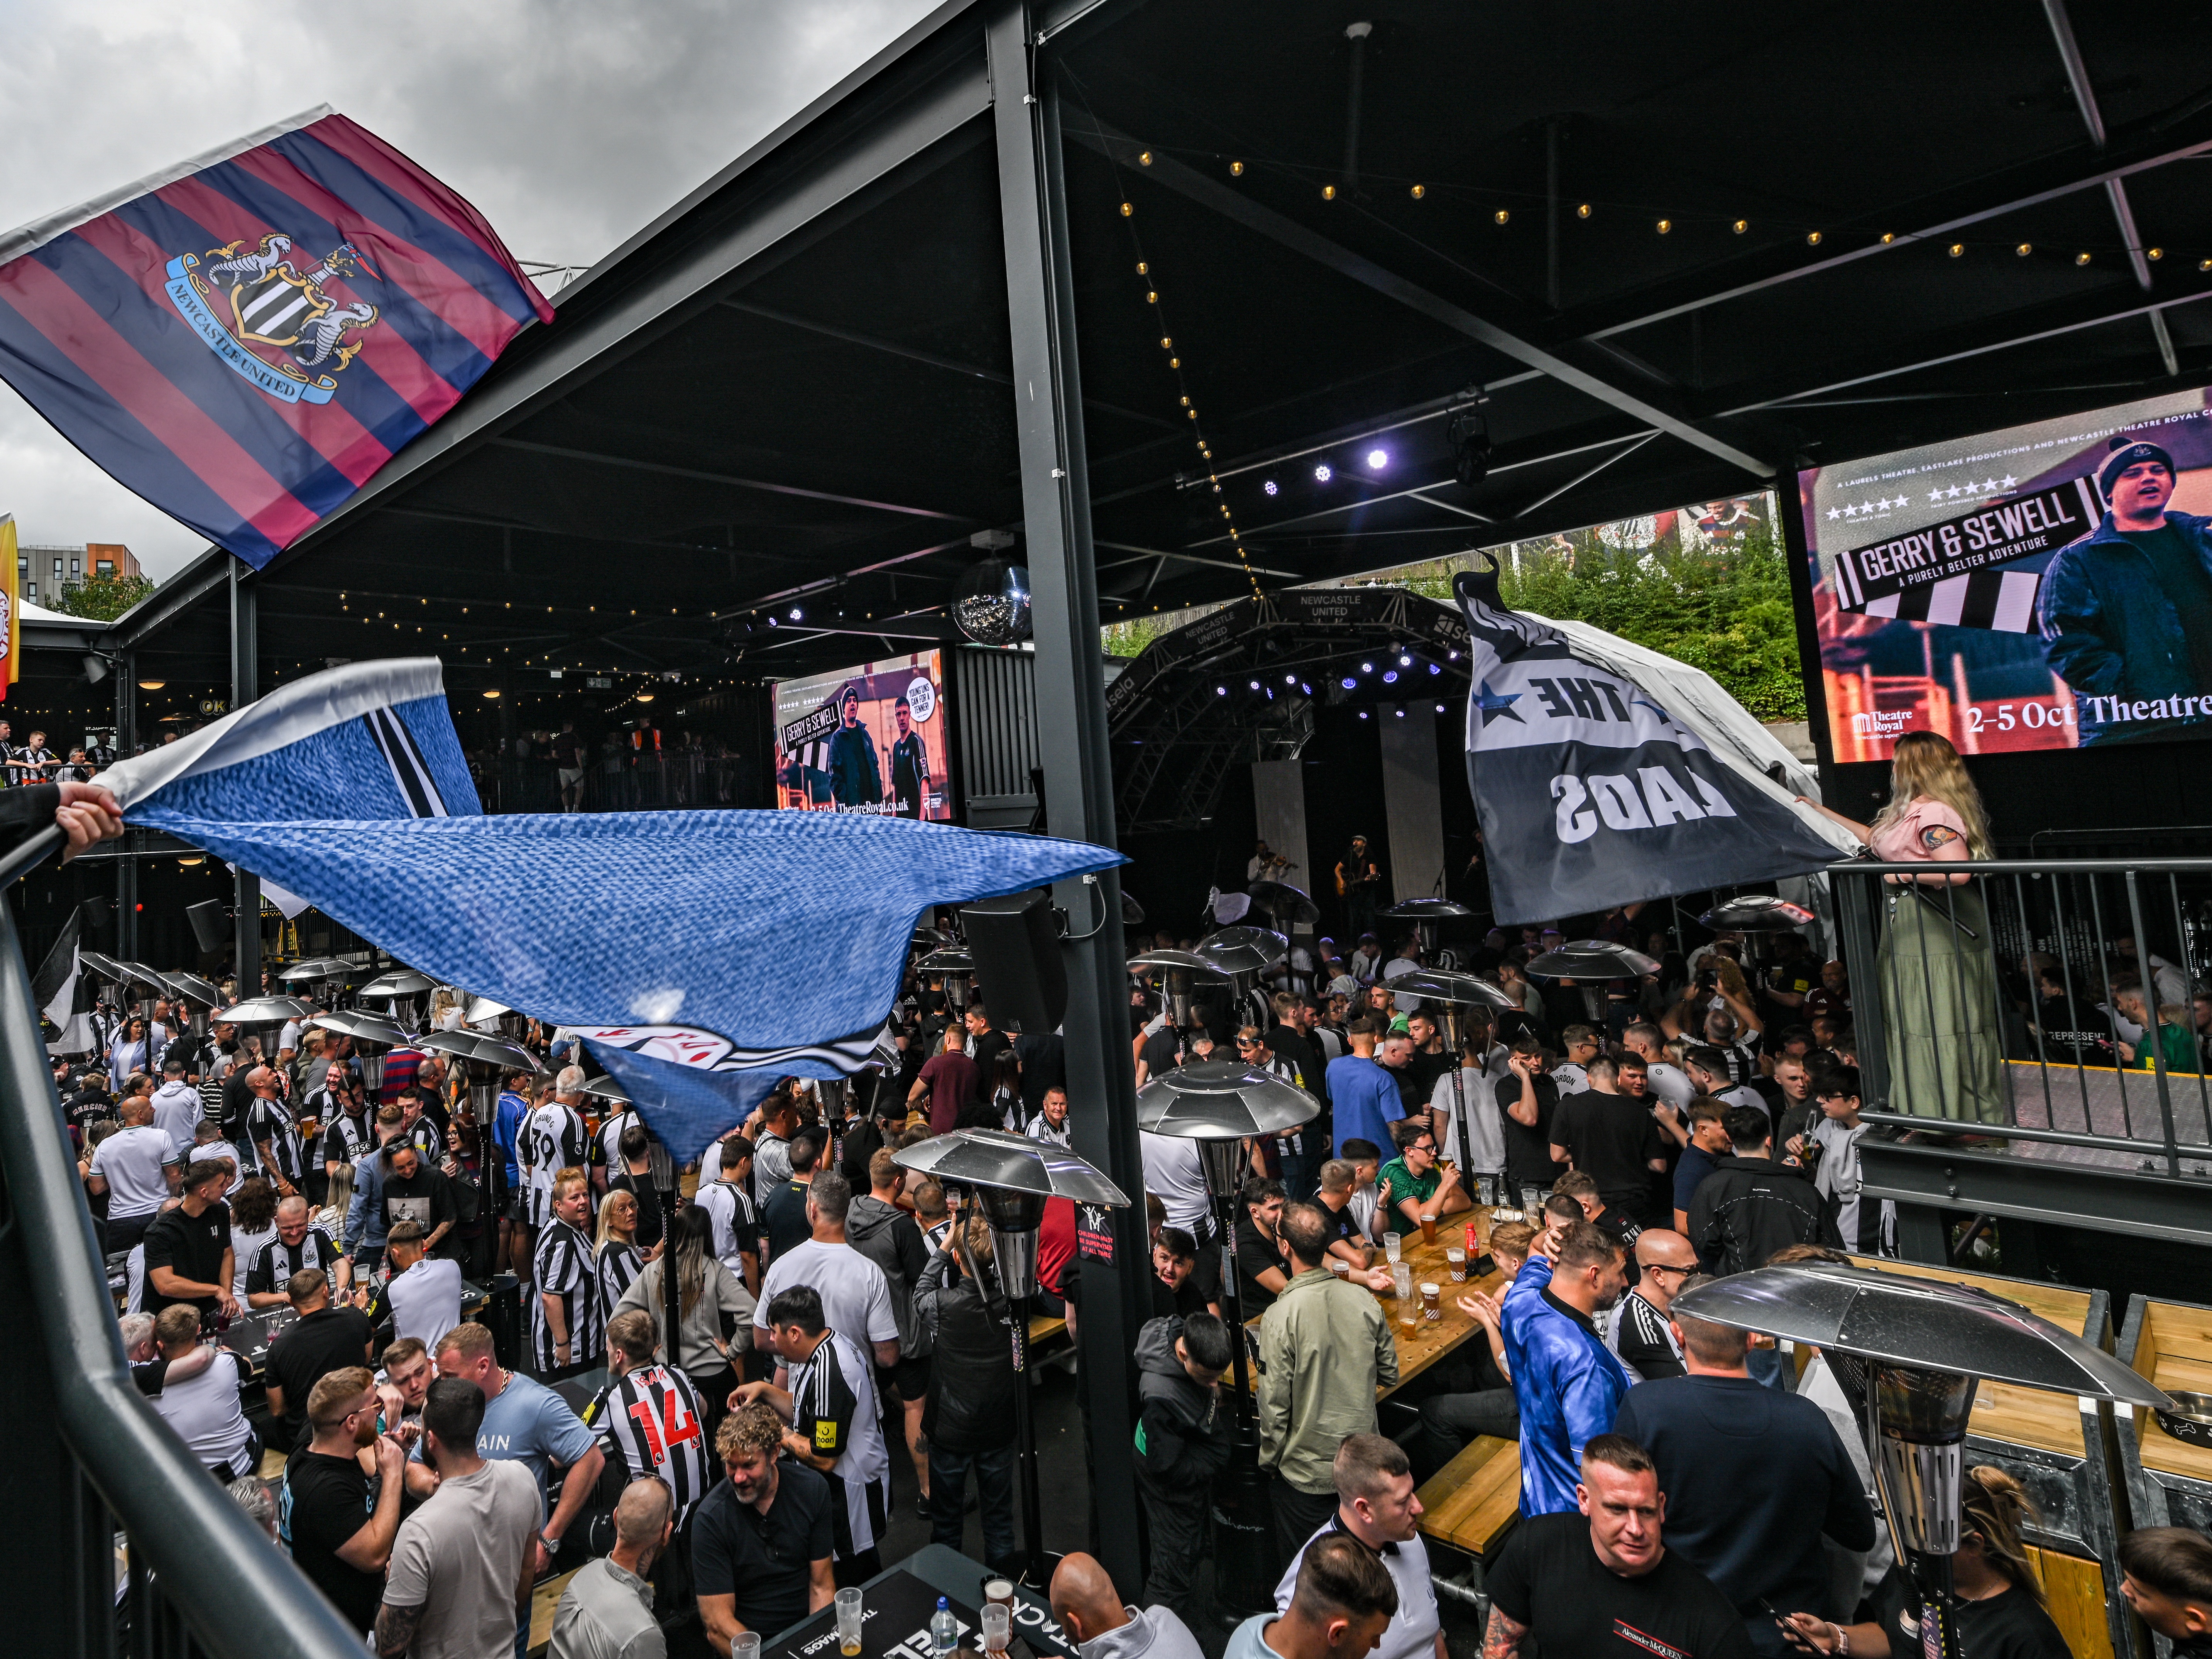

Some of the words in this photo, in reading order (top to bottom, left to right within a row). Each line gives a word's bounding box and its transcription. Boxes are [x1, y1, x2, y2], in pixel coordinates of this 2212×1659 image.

[171, 284, 240, 362] NEWCASTLE
[241, 362, 295, 397] UNITED
[1845, 475, 1879, 487] LAURELS
[1921, 458, 1964, 472] EASTLAKE
[1966, 445, 2031, 463] PRODUCTIONS
[2034, 441, 2054, 450] AND
[2057, 428, 2114, 445] NEWCASTLE
[2119, 419, 2161, 433] THEATRE
[2165, 412, 2198, 424] ROYAL
[1976, 490, 2017, 502] PRODUCTIONS
[1860, 530, 1937, 581] GERRY
[1940, 524, 1962, 557] &
[1963, 492, 2076, 550] SEWELL
[1899, 577, 1905, 587] A
[1908, 566, 1944, 585] PURELY
[1947, 554, 1985, 574] BELTER
[1989, 535, 2048, 561] ADVENTURE
[1301, 595, 1361, 605] NEWCASTLE
[1311, 607, 1348, 616] UNITED
[1185, 611, 1235, 639] NEWCASTLE
[1197, 626, 1228, 645] UNITED
[909, 683, 930, 698] YOUNG'UNS
[927, 692, 930, 700] A
[1109, 676, 1135, 706] sela
[200, 699, 227, 715] OK
[914, 702, 929, 714] TENNER!
[1870, 710, 1913, 721] Theatre
[2022, 702, 2077, 728] Oct
[786, 719, 805, 742] GERRY
[806, 717, 811, 733] &
[811, 706, 837, 731] SEWELL
[817, 726, 831, 737] ADVENTURE
[1874, 719, 1903, 733] Royal
[838, 797, 909, 815] TheatreRoyal.co.uk
[2037, 939, 2046, 951] OH
[1555, 1074, 1576, 1086] ORDON
[73, 1103, 107, 1116] MERCIER
[534, 1114, 551, 1125] BRUNO
[532, 1127, 556, 1172] 39
[1078, 1230, 1099, 1240] CHILDREN
[1100, 1235, 1113, 1243] MUST
[1086, 1239, 1113, 1250] SUPERVISED
[1097, 1250, 1111, 1258] TIMES
[634, 1368, 666, 1388] ISAK
[628, 1388, 700, 1467] 14
[477, 1434, 510, 1451] AIN
[1622, 1627, 1650, 1647] Alexander
[1650, 1644, 1682, 1659] McQUEEN
